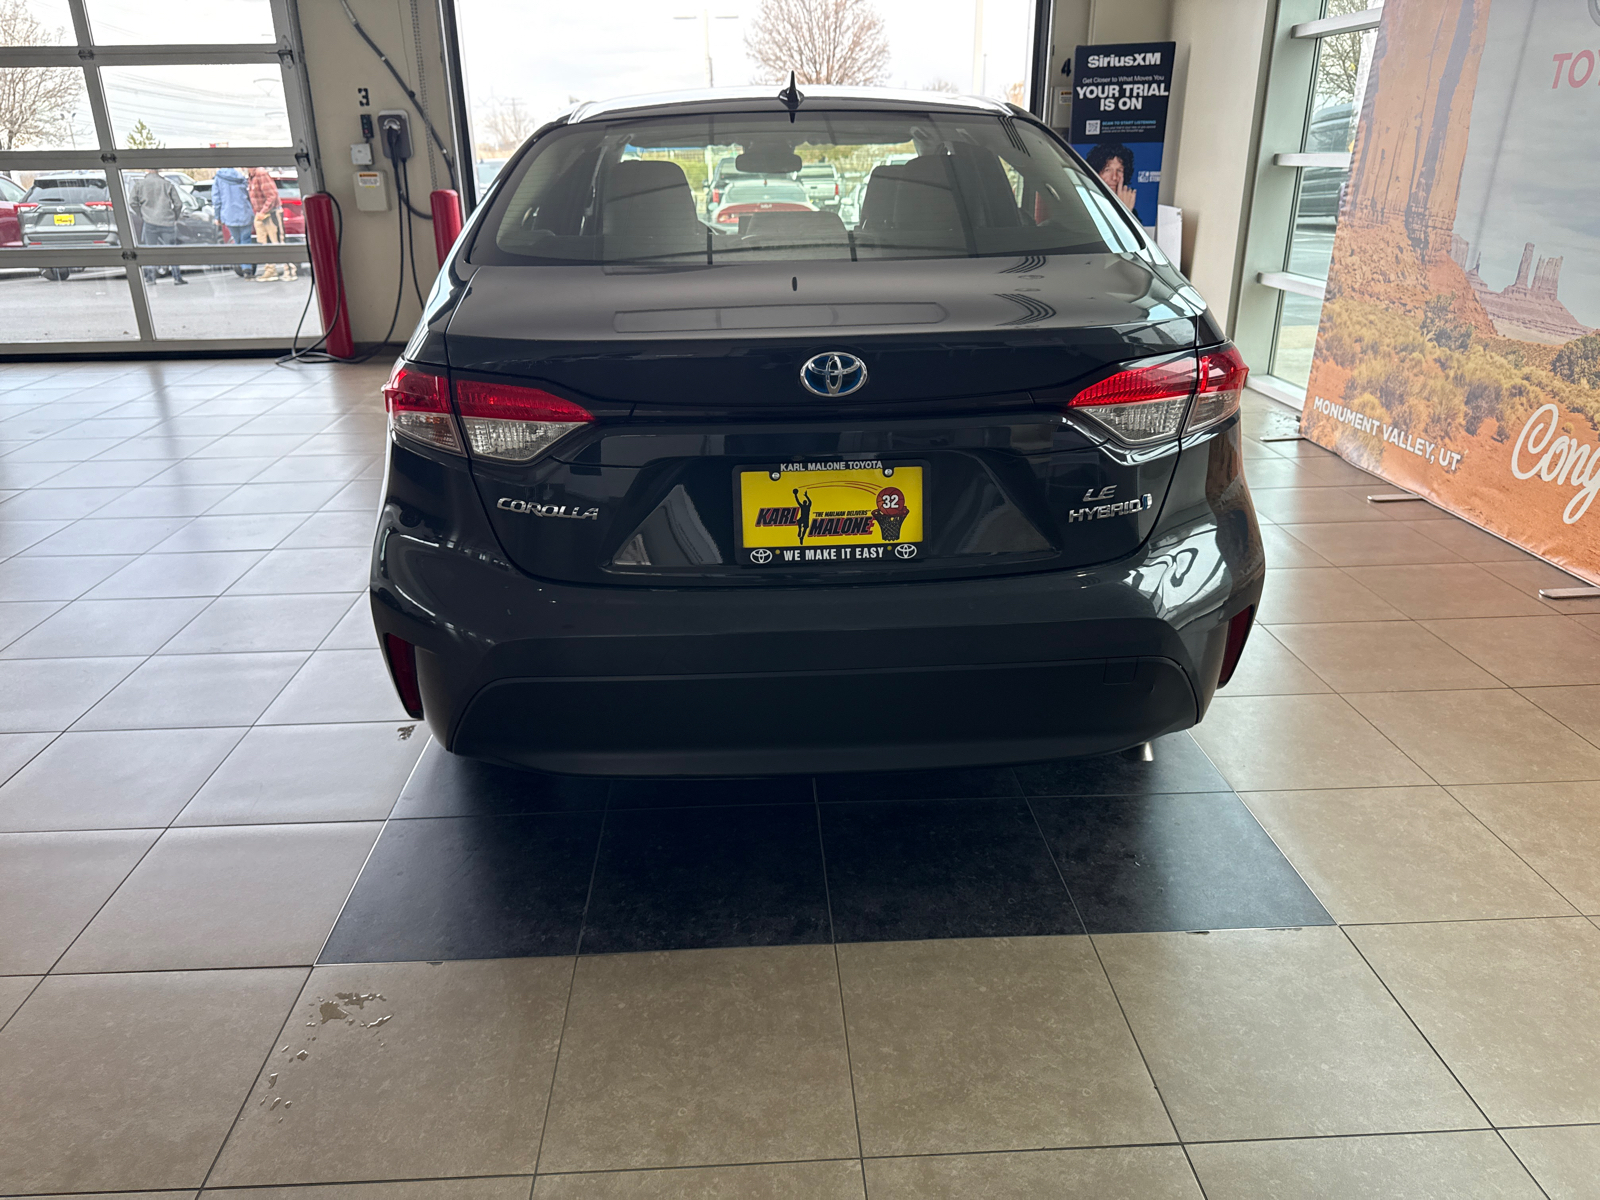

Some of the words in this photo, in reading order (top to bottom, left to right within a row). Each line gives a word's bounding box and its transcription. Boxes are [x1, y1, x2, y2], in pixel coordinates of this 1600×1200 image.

[1061, 58, 1071, 77] 4
[1087, 52, 1161, 69] SiriusXM
[1552, 49, 1600, 89] TO
[358, 88, 370, 106] 3
[1076, 84, 1120, 99] YOUR
[1122, 83, 1169, 97] TRIAL
[1100, 98, 1115, 111] IS
[1118, 97, 1143, 111] ON
[1314, 396, 1380, 436] MONUMENT
[1382, 424, 1435, 465] VALLEY,
[1438, 447, 1461, 471] UT
[780, 463, 805, 472] KARL
[808, 461, 846, 471] MALONE
[849, 460, 883, 470] TOYOTA
[882, 494, 899, 509] 32
[1083, 484, 1118, 502] LE
[496, 497, 599, 520] COROLLA
[755, 507, 800, 527] KARL
[1068, 498, 1143, 523] HYBRID
[807, 516, 875, 537] MALONE
[783, 550, 801, 561] WE
[805, 549, 837, 560] MAKE
[841, 548, 852, 559] IT
[855, 547, 884, 559] EASY
